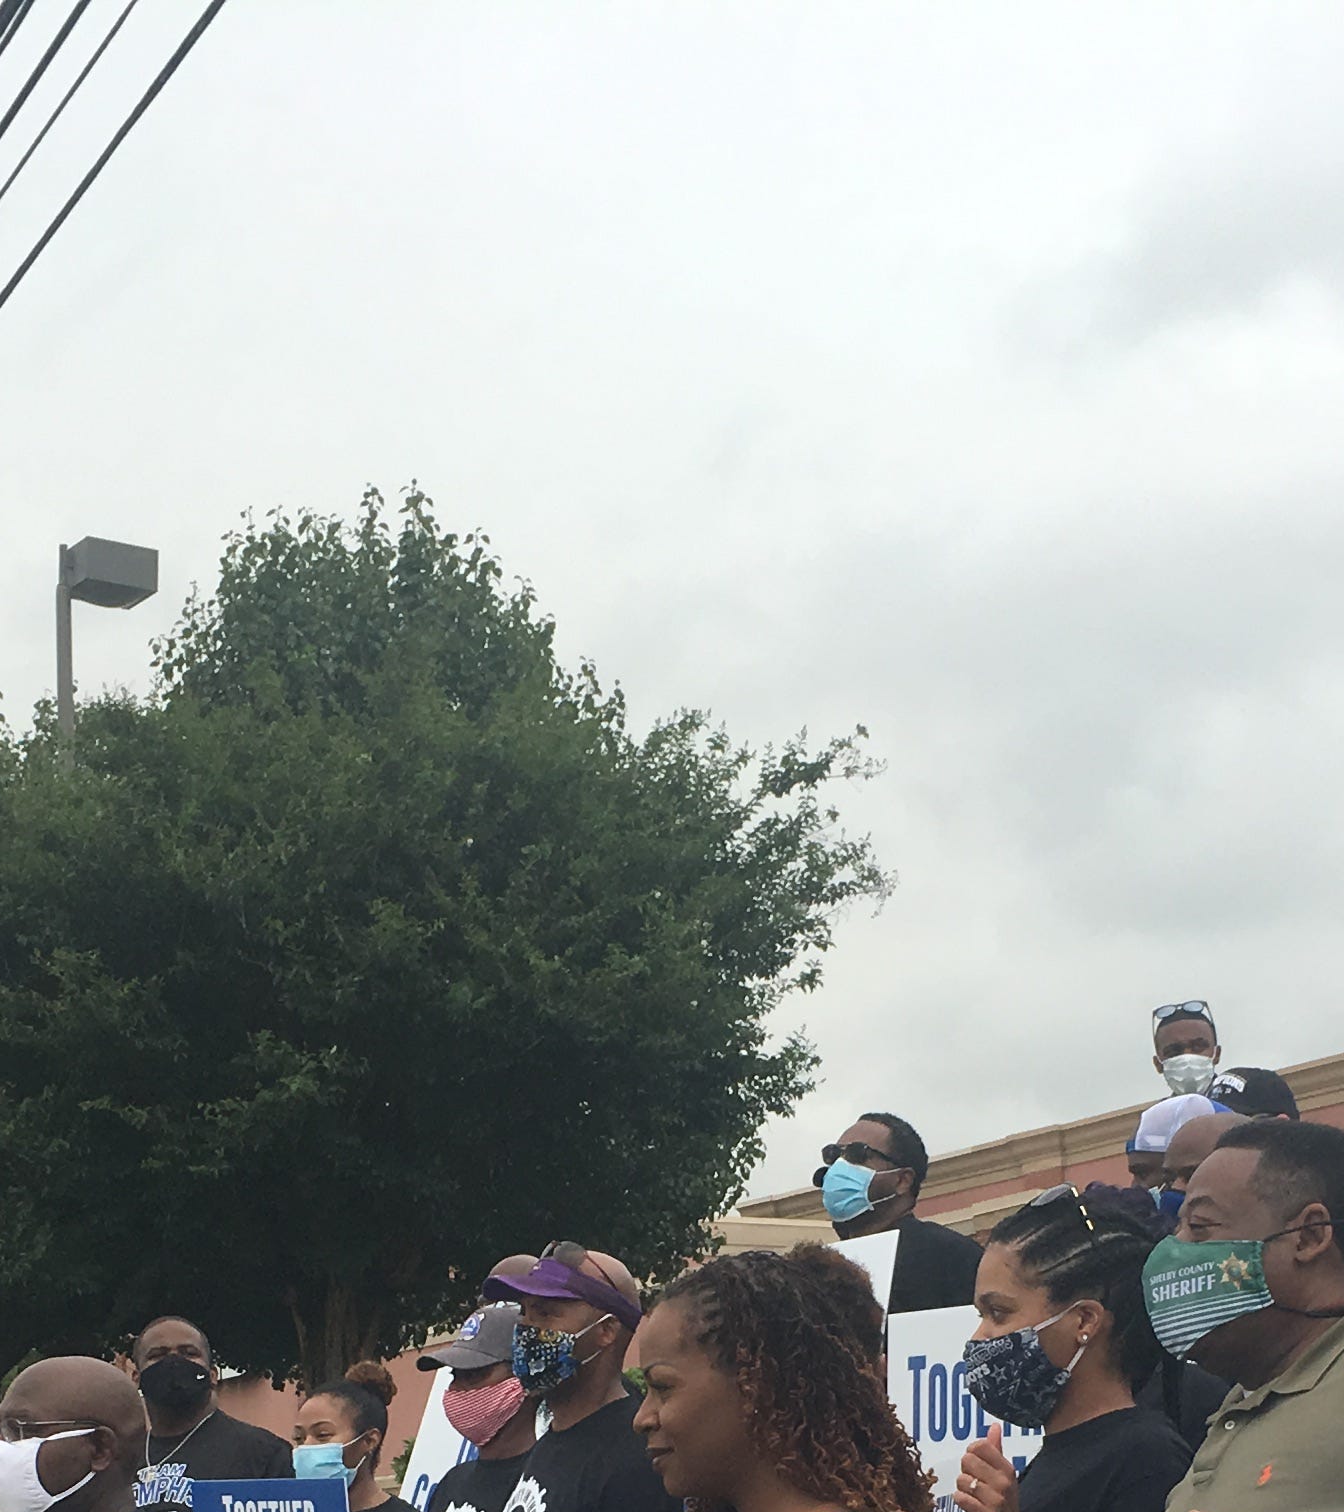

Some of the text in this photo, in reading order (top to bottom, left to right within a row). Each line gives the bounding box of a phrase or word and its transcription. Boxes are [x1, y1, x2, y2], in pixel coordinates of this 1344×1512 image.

[1149, 1261, 1216, 1286] SHELBY COUNTY
[1151, 1273, 1216, 1304] SHERIFF
